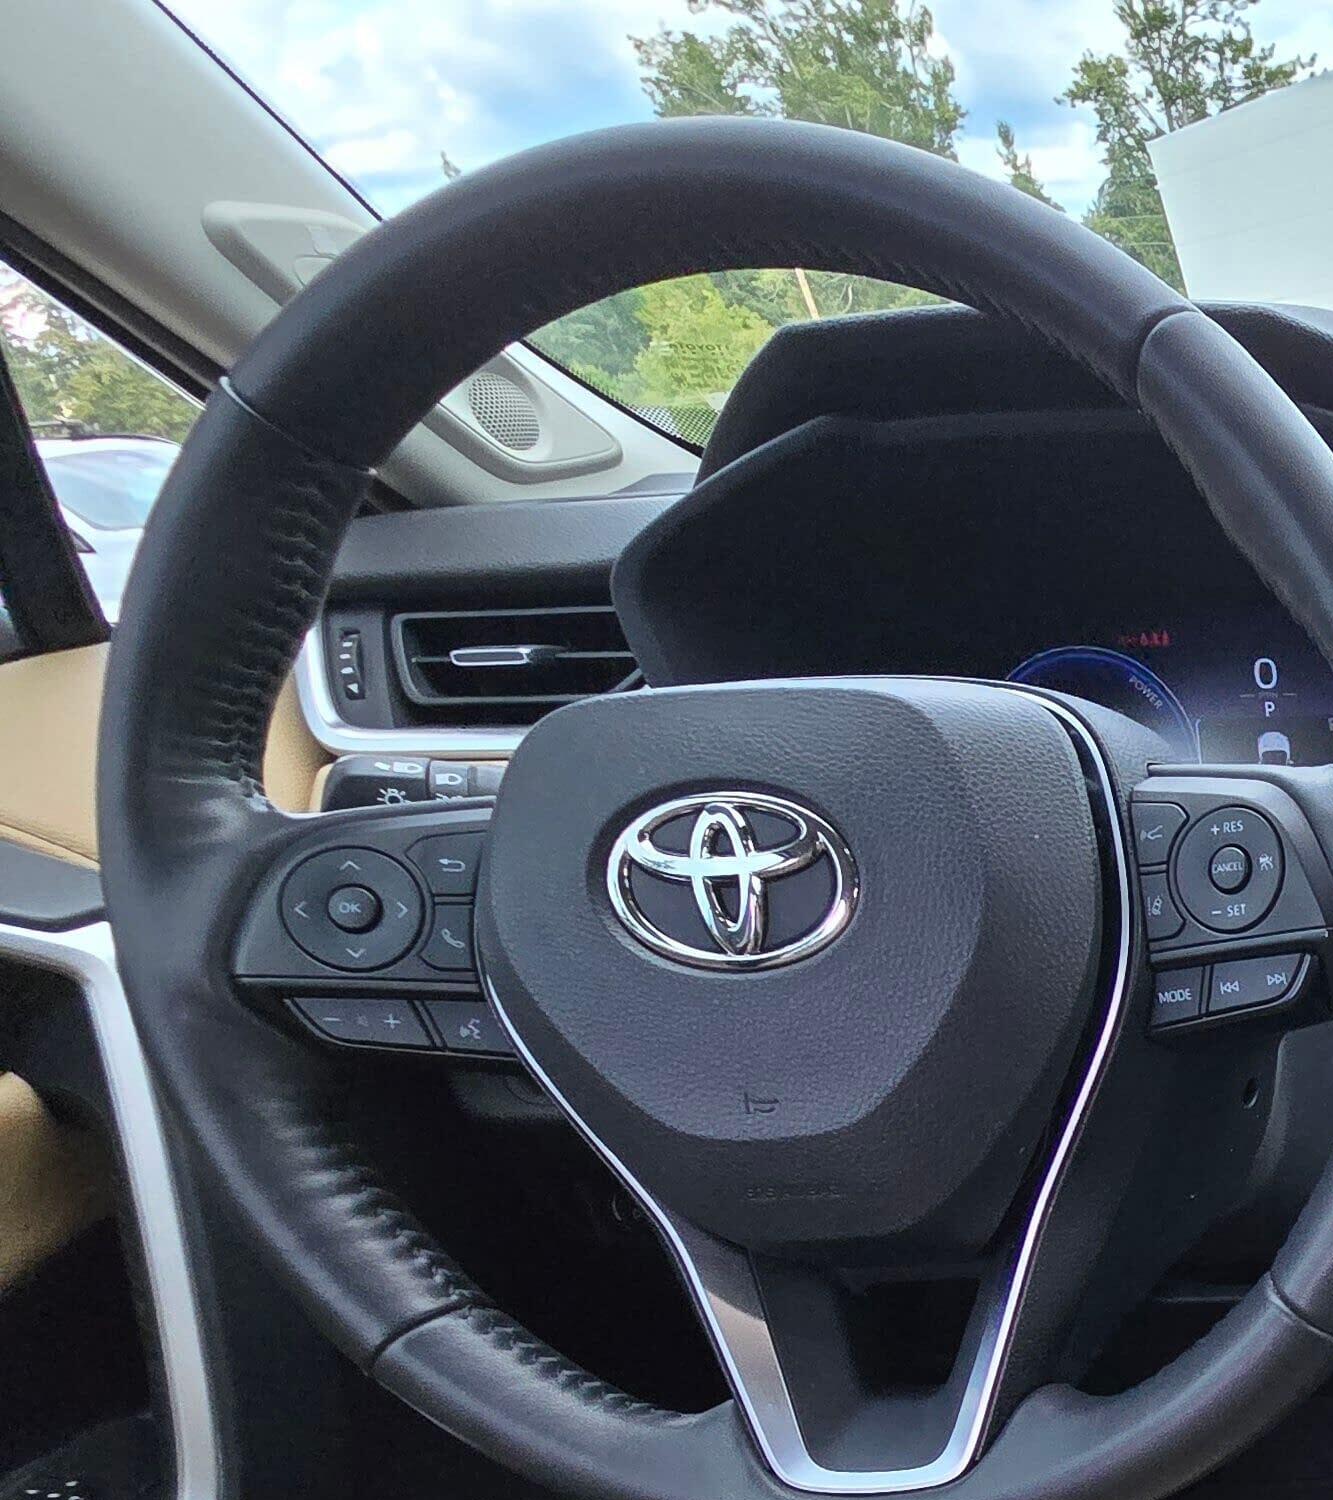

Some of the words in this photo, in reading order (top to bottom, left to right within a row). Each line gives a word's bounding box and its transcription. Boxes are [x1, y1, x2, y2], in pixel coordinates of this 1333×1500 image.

[1253, 657, 1278, 689] 0
[1128, 674, 1163, 710] POWER
[1264, 701, 1276, 717] P
[1222, 820, 1244, 833] RES
[1211, 861, 1243, 873] CANCEL
[340, 902, 361, 913] OK
[1227, 904, 1246, 917] SET
[1158, 988, 1193, 1004] MODE
